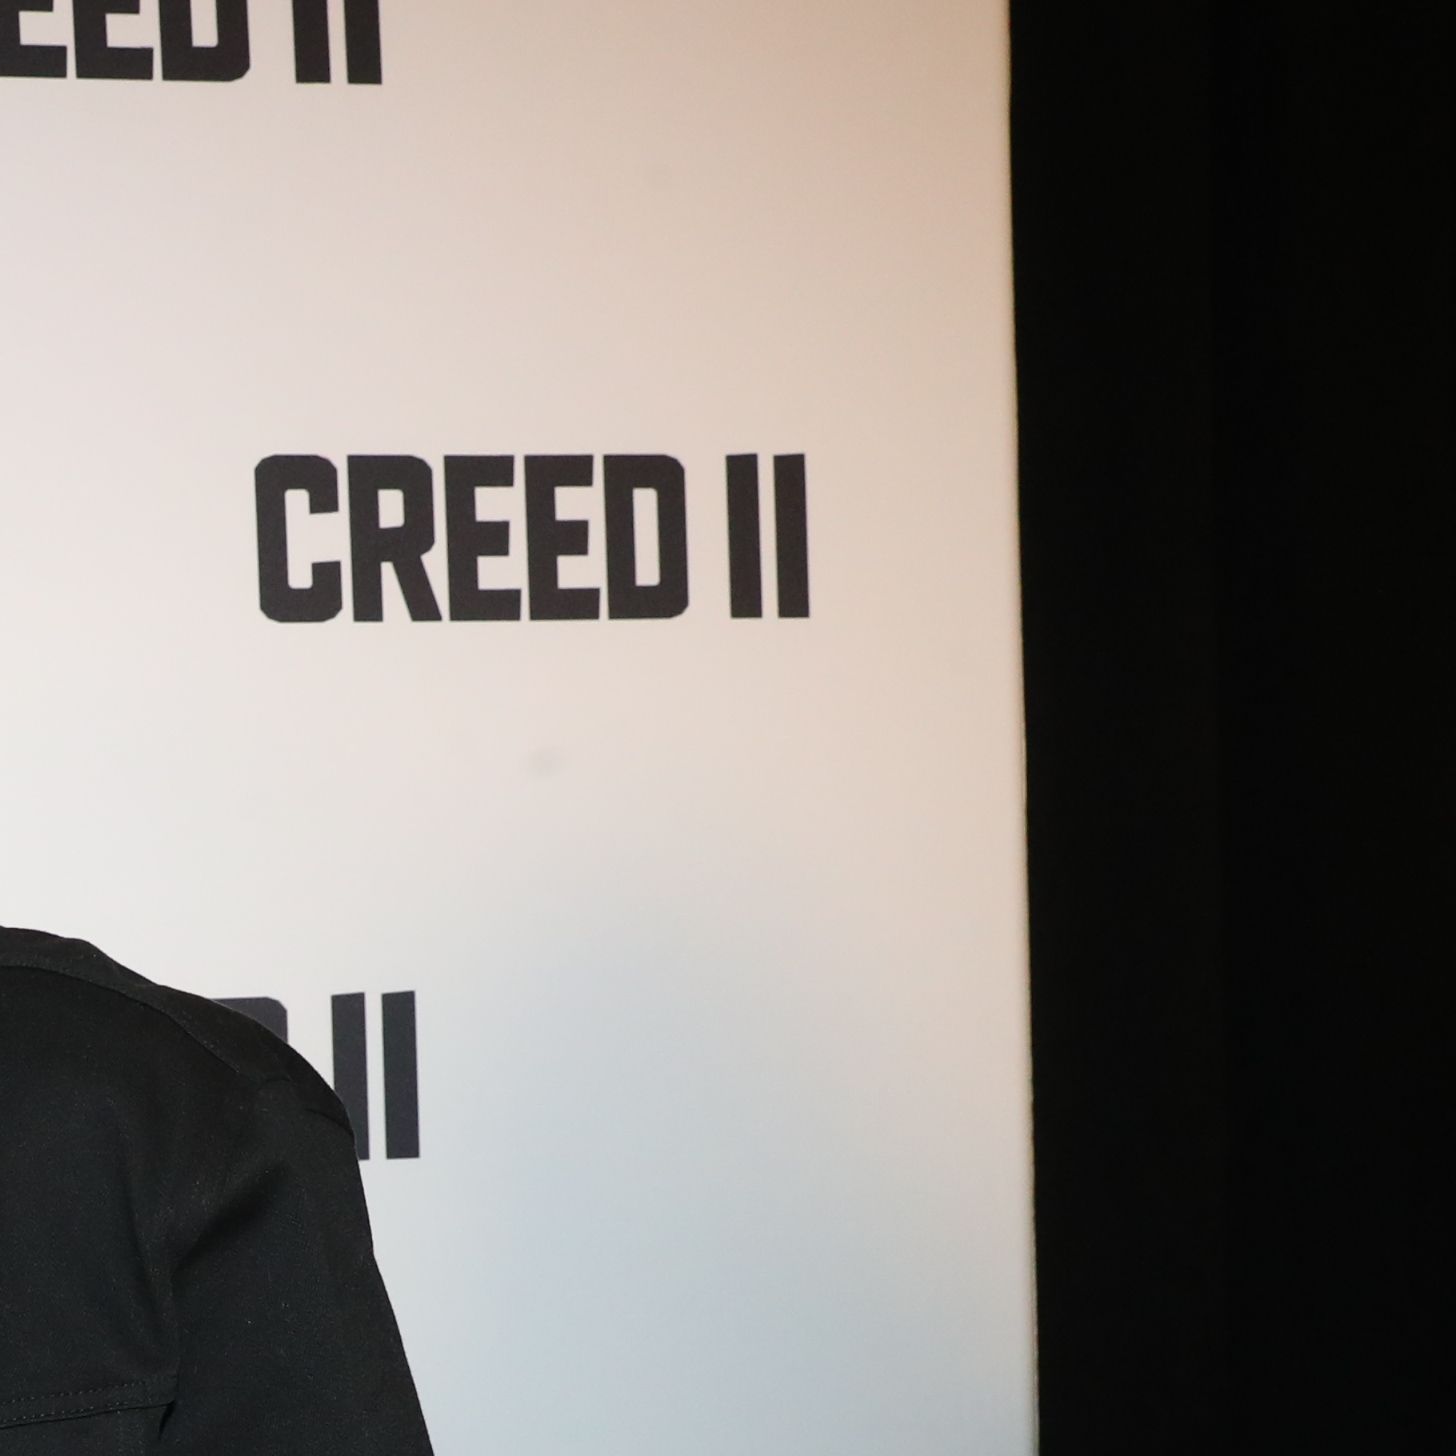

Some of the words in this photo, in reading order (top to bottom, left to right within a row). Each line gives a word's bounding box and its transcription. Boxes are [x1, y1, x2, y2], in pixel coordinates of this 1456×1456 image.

[254, 454, 689, 623] CREED
[725, 453, 810, 619] II
[331, 990, 420, 1161] II
